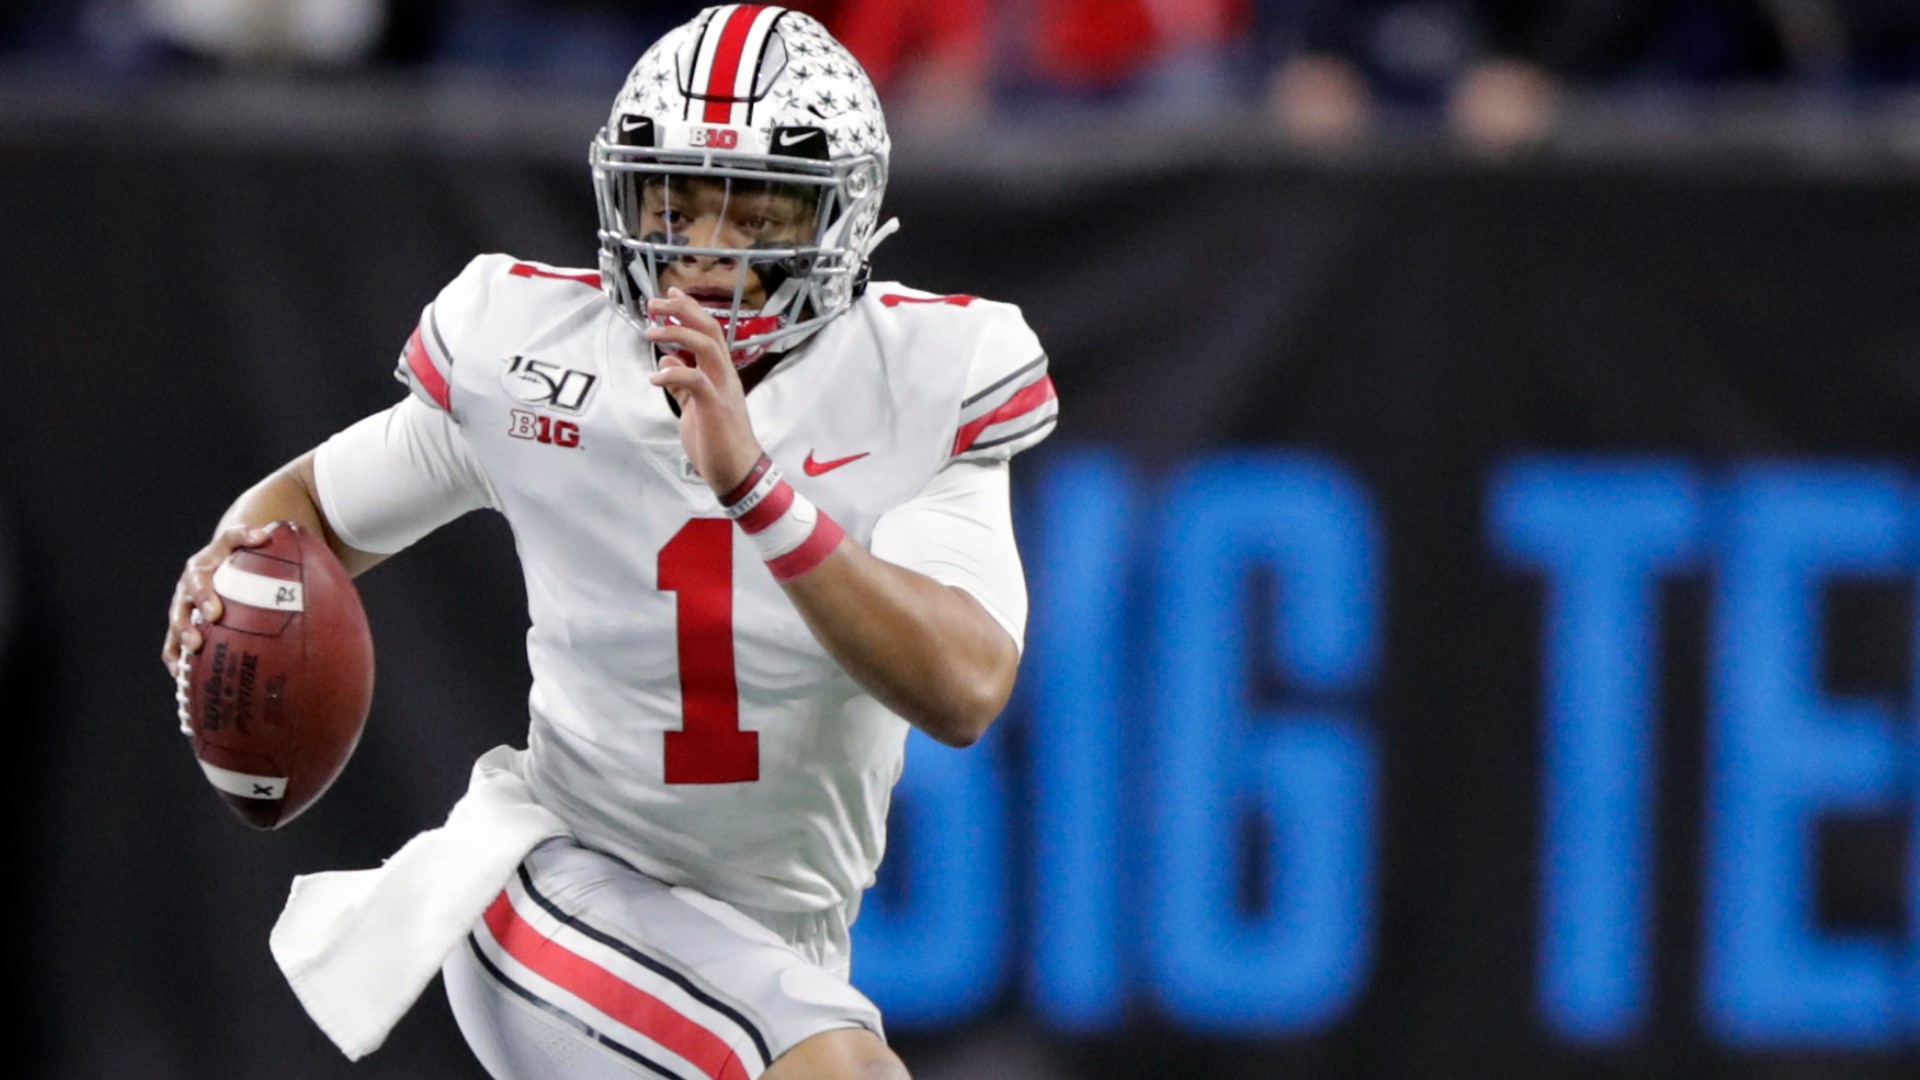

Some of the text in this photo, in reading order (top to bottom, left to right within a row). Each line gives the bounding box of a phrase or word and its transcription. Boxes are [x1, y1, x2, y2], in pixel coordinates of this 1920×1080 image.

[508, 355, 596, 410] 150
[657, 518, 759, 784] 1
[1488, 458, 1920, 1042] TE
